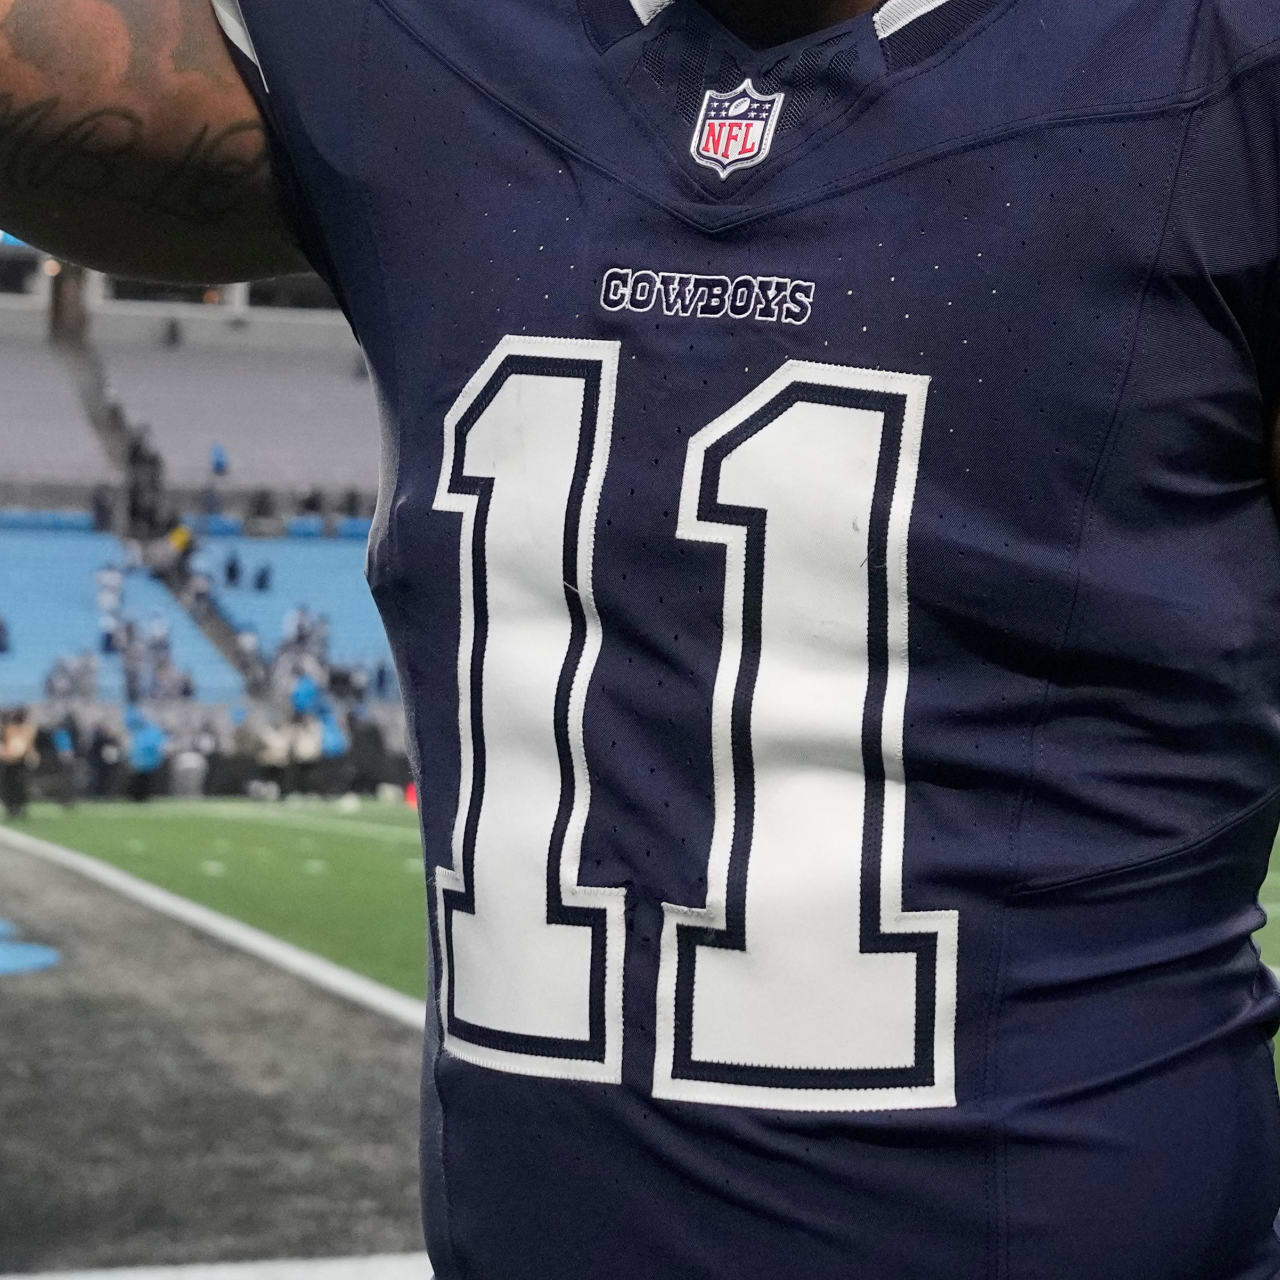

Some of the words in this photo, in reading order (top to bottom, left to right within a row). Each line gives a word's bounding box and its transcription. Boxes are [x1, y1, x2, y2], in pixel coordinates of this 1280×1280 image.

[701, 121, 756, 160] NFL
[600, 268, 816, 325] COWBOYS
[432, 335, 959, 1109] 11
